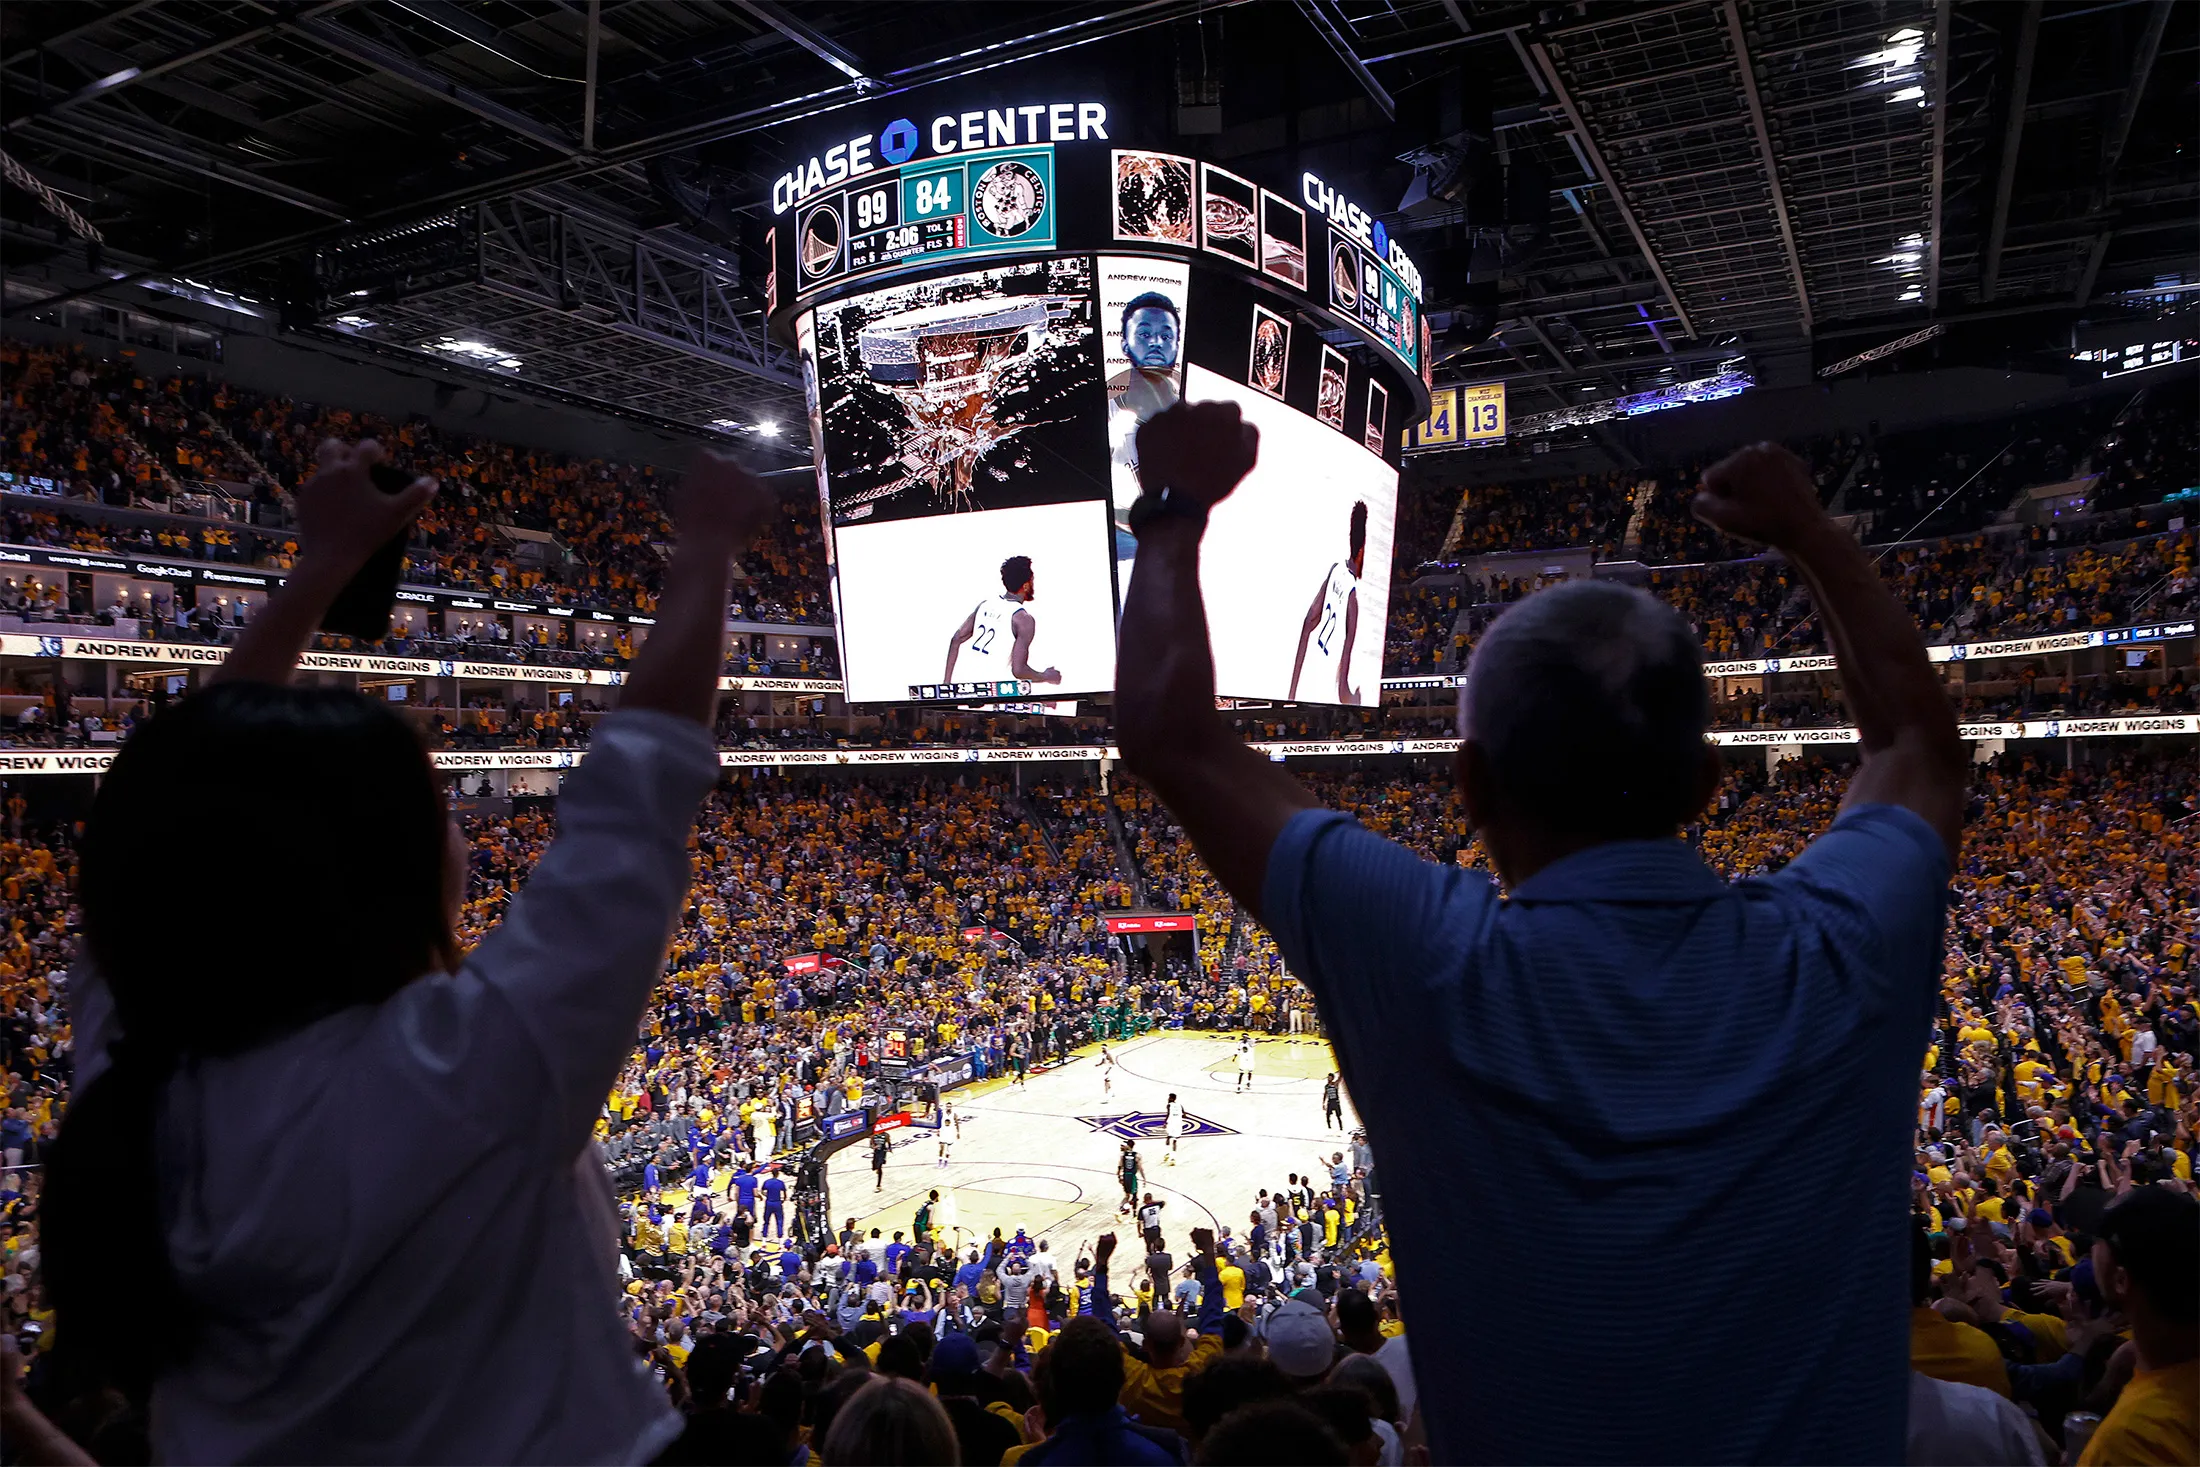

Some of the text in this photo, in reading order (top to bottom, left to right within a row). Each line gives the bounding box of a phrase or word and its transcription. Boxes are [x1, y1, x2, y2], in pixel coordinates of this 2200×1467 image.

[773, 102, 1109, 215] CHASE CENTER
[916, 176, 951, 215] 84
[1024, 170, 1043, 214] CELTICS
[857, 190, 887, 229] 99
[975, 183, 991, 227] BOSTON
[926, 220, 953, 233] TOL 2
[853, 236, 875, 250] TOL 1
[885, 226, 919, 251] 2:06
[926, 236, 953, 249] FLS 3
[1303, 171, 1423, 304] CHASE CENTER
[853, 251, 875, 266] FLS 5
[892, 246, 925, 258] QUARTER
[1107, 274, 1182, 286] ANDREW WIGGINS
[1425, 409, 1449, 437] 14
[1472, 403, 1498, 432] 13
[137, 564, 168, 577] Google
[168, 568, 192, 578] Cloud
[396, 591, 435, 602] ORACLE
[1318, 603, 1336, 656] 22
[972, 624, 995, 655] 22
[1973, 634, 2089, 655] ANDREW WIGGINS
[75, 642, 161, 658] ANDREW
[298, 655, 430, 672] ANDREW WIGGINS
[1703, 663, 1757, 673] WIGGINS
[463, 665, 573, 680] ANDREW WIGGINS
[753, 680, 800, 688] ANDREW
[2065, 719, 2186, 733] ANDREW WIGGINS
[1732, 732, 1852, 743] ANDREW WIGGINS
[1282, 743, 1384, 753] ANDREW WIGGINS
[1412, 742, 1462, 750] ANDREW
[434, 755, 553, 765] ANDREW WIGGINS
[727, 754, 827, 763] ANDREW WIGGINS
[858, 752, 960, 761] ANDREW WIGGINS
[986, 750, 1088, 759] ANDREW WIGGINS
[885, 1040, 906, 1057] 24
